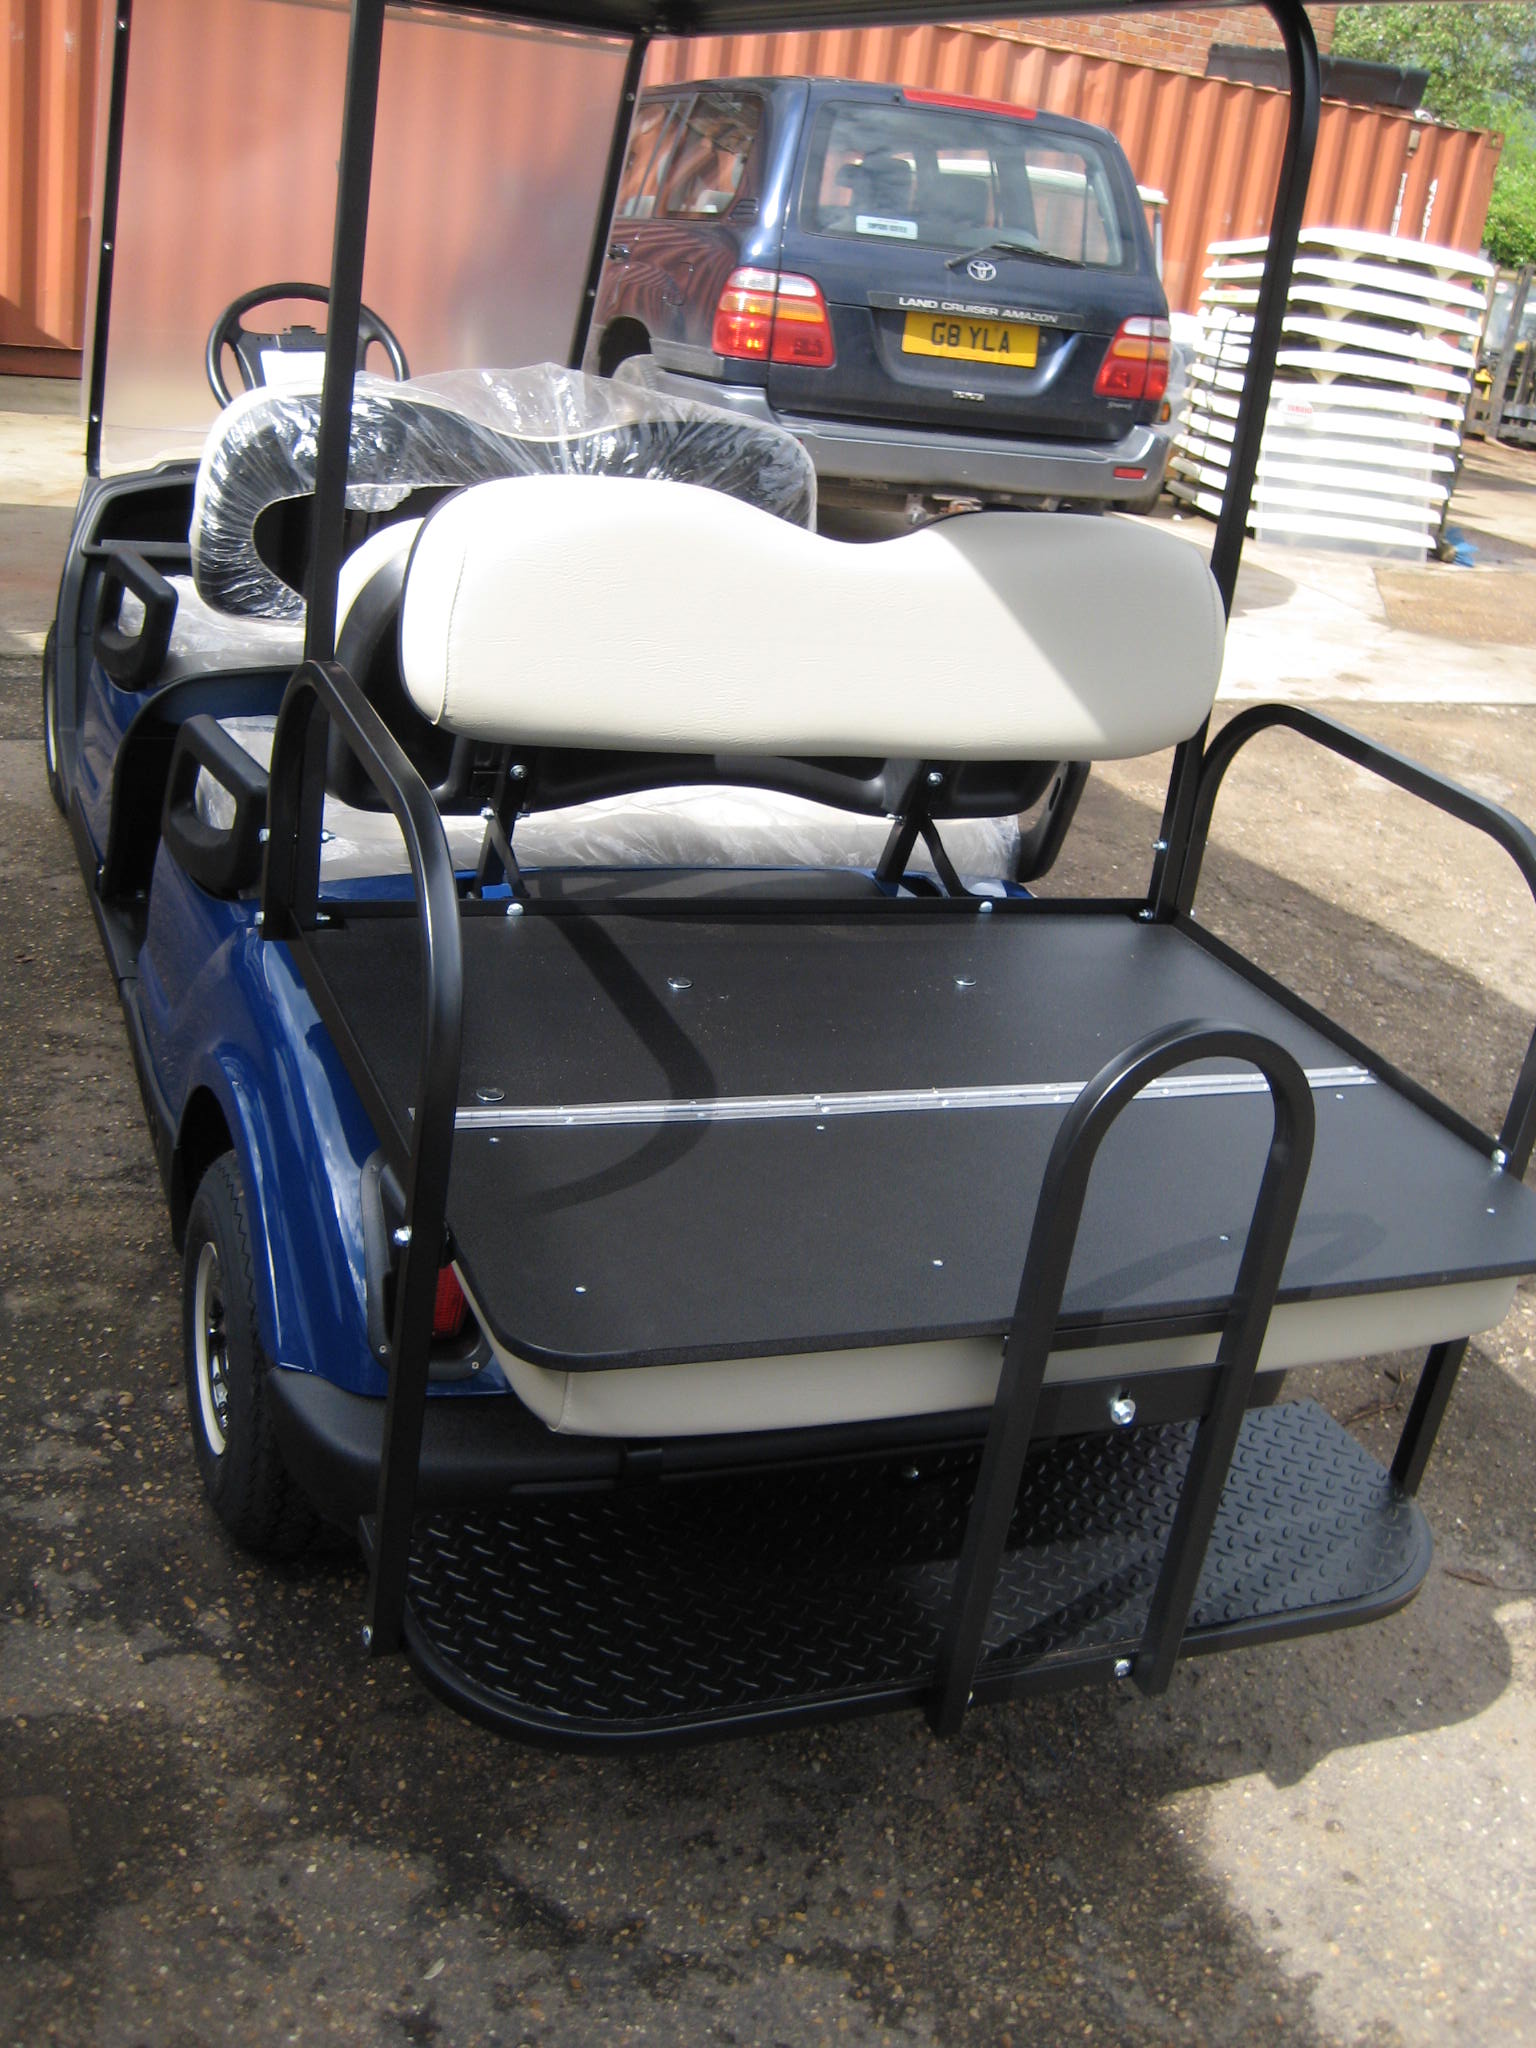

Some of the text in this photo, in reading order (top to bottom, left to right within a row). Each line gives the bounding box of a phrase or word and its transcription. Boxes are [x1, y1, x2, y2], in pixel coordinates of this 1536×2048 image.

[898, 297, 1059, 324] LAND CRUISER AMAZON
[931, 321, 1011, 354] G8 YLA
